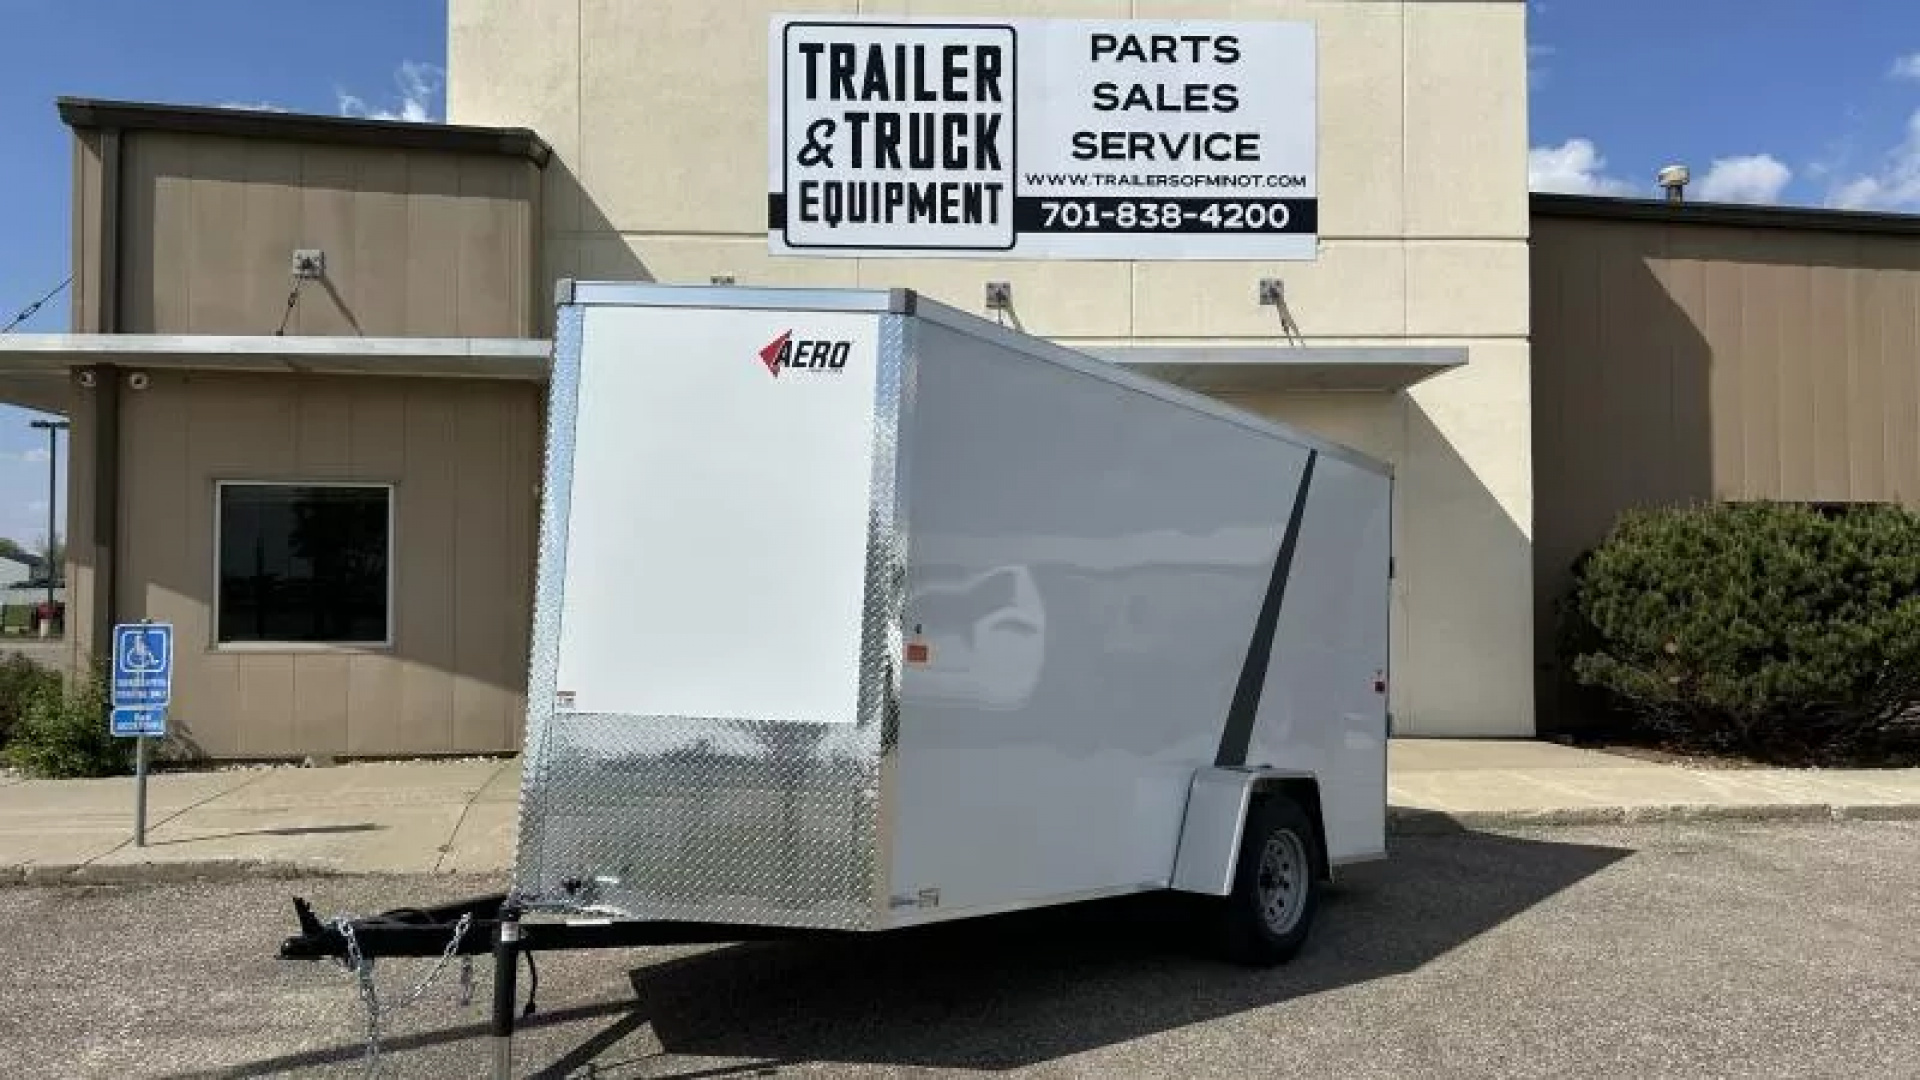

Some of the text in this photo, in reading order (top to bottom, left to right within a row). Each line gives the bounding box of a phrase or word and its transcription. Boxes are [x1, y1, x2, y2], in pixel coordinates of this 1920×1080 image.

[1091, 33, 1241, 63] PARTS
[799, 42, 1001, 102] TRAILER
[1092, 82, 1240, 113] SALES
[797, 112, 1002, 170] & TRUCK
[1071, 131, 1261, 162] SERVICE
[1025, 173, 1307, 188] WWW.TRAILERSOFMINOT.COM
[799, 180, 1003, 228] EQUIPMENT
[1041, 202, 1290, 229] 701-838-4200
[773, 340, 851, 368] AERO
